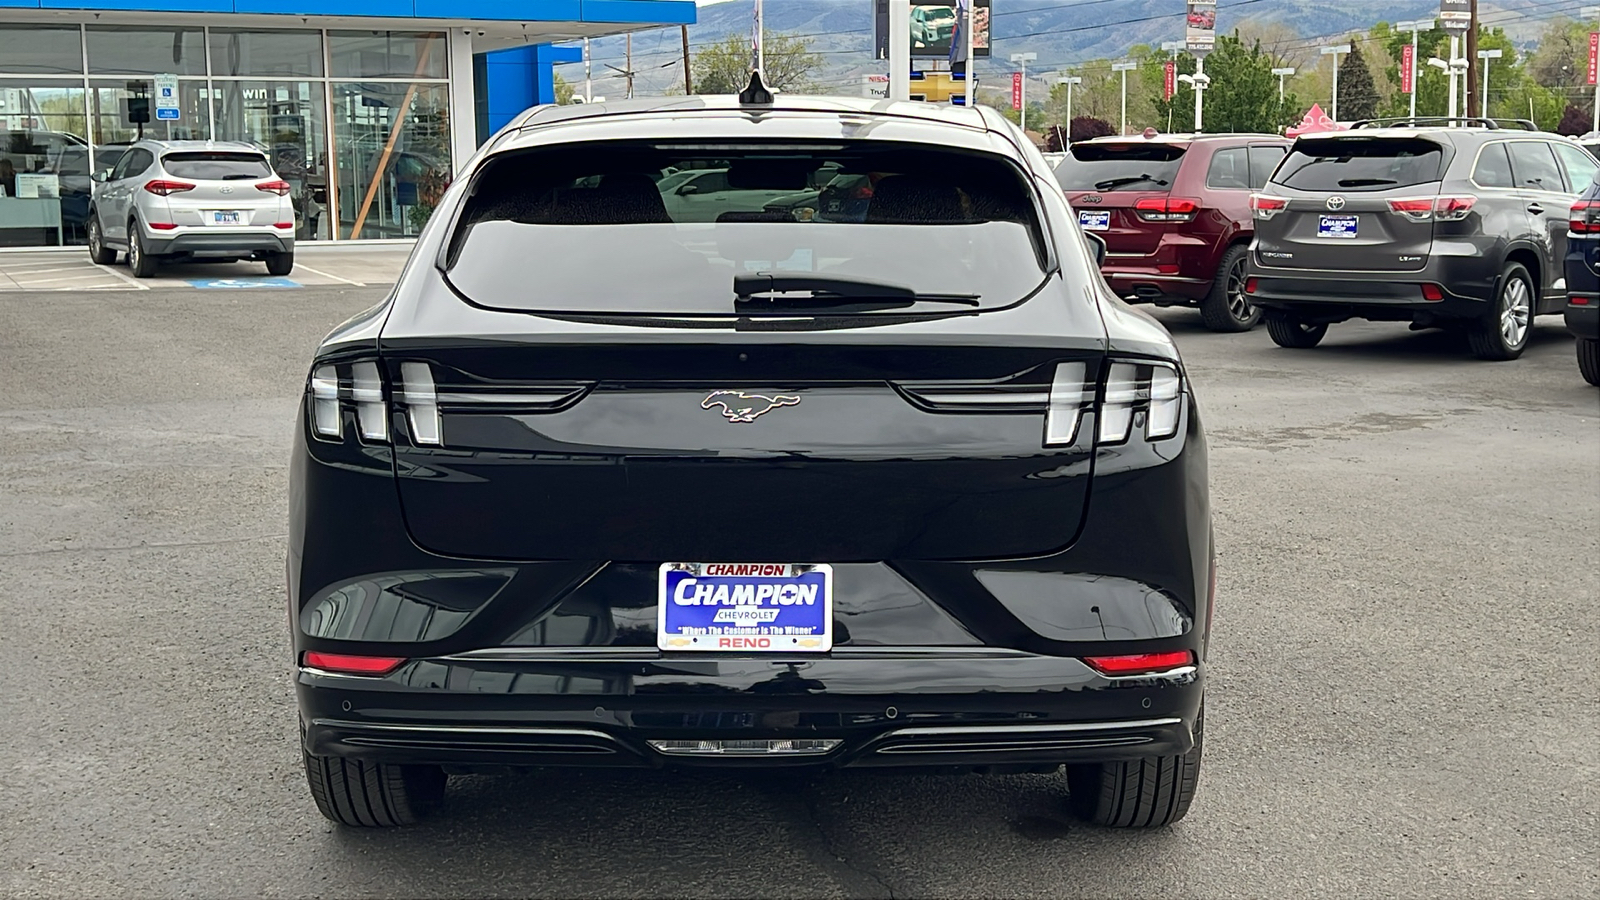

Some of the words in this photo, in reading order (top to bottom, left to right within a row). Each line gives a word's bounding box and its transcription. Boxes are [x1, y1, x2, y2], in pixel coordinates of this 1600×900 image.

[242, 88, 268, 99] win
[1082, 194, 1102, 203] Jeep
[1321, 218, 1356, 227] CHAMPION
[706, 564, 785, 576] CHAMPION
[674, 578, 818, 606] CHAMPION
[718, 611, 774, 619] CHEVROLET
[708, 626, 723, 635] The
[725, 626, 760, 635] Customer
[769, 626, 784, 635] The
[719, 637, 771, 648] RENO
